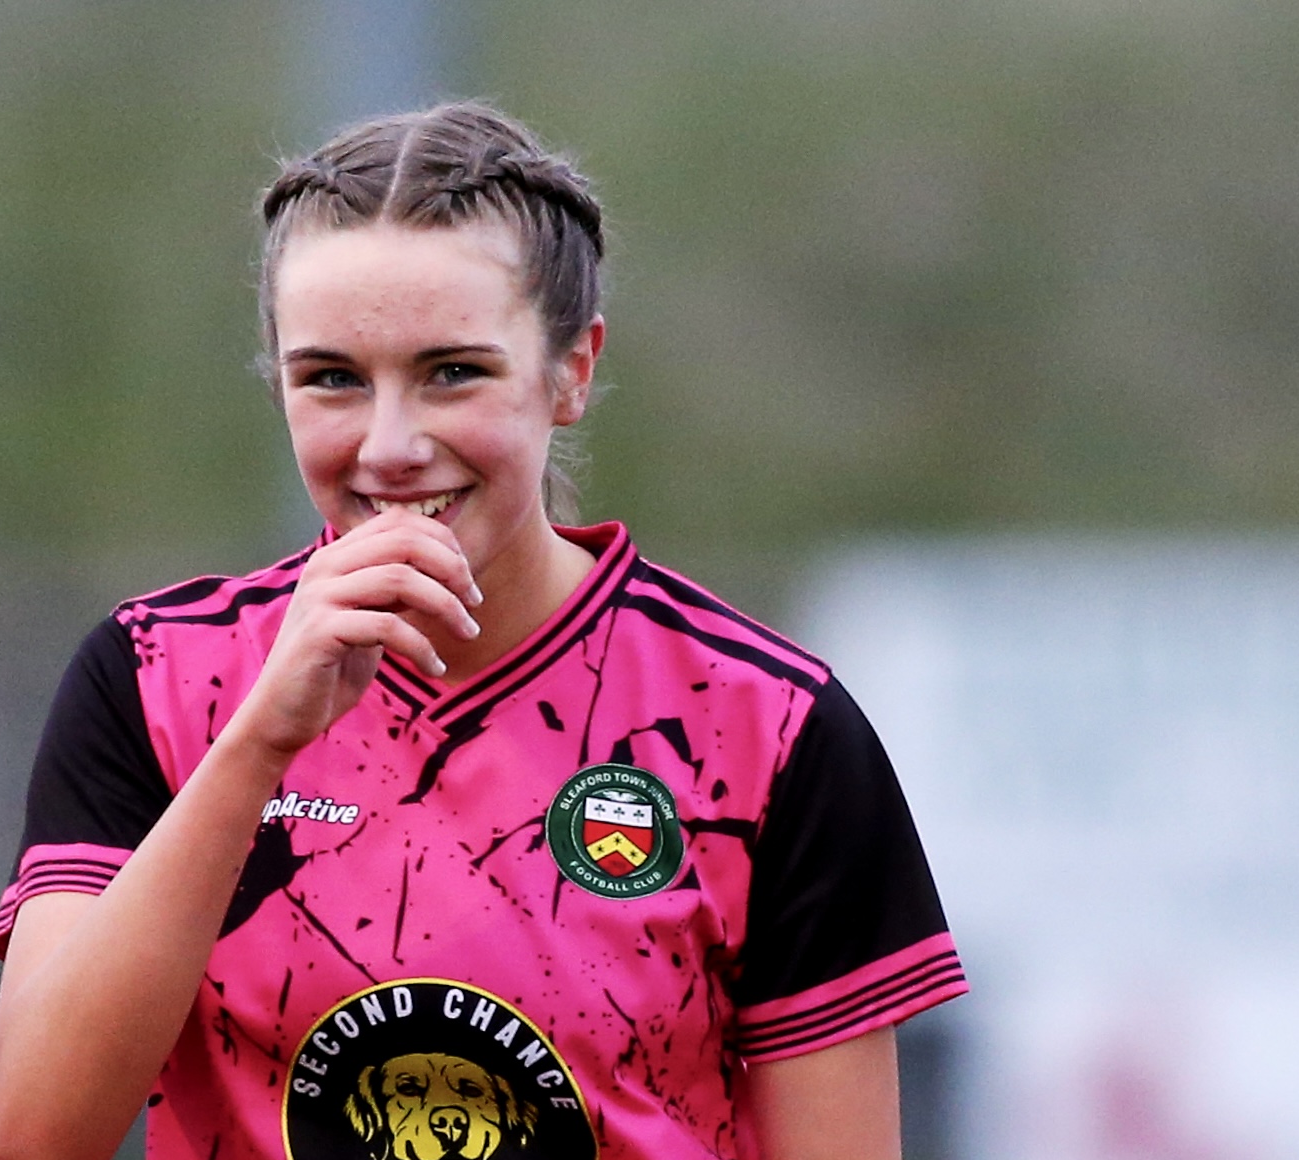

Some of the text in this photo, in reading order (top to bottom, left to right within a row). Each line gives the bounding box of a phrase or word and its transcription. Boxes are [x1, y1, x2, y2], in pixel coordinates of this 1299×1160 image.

[261, 792, 359, 824] pActive
[559, 772, 674, 821] SLEAFORD TOWN JUNIOR
[569, 860, 663, 892] FOOTBALL CLUB
[292, 986, 579, 1111] SECOND CHANCE
